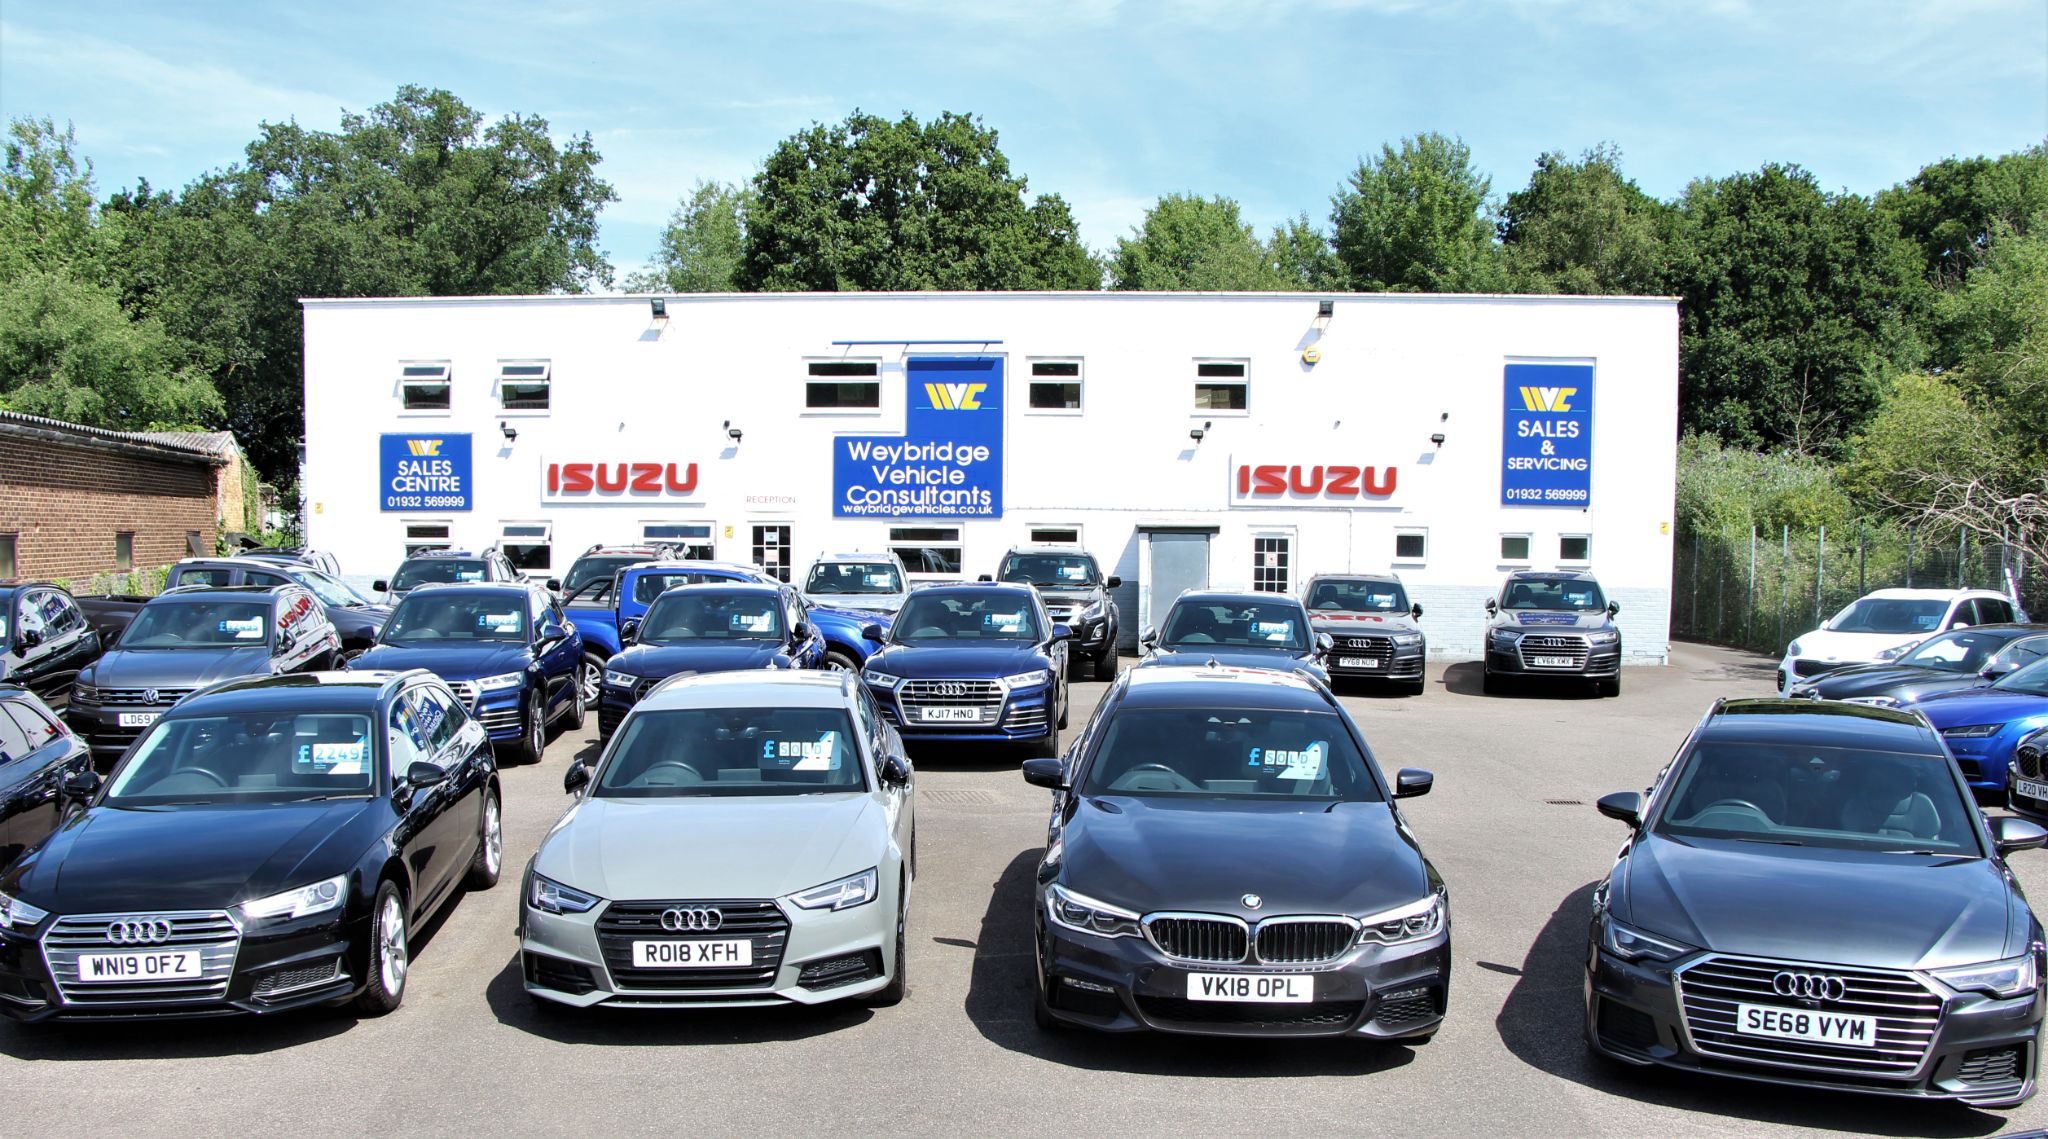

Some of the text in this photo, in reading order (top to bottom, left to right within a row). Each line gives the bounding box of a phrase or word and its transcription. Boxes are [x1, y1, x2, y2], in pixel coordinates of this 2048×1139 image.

[1517, 420, 1579, 438] SALES
[848, 441, 990, 466] Weybridge
[1540, 439, 1555, 455] &
[398, 460, 452, 476] SALES
[1507, 457, 1588, 471] SERVICING
[547, 463, 698, 492] ISUZU
[872, 465, 965, 484] Vehicle
[1239, 465, 1397, 496] ISUZU
[391, 476, 461, 492] CENTRE
[387, 496, 465, 507] 01932 569999
[746, 495, 796, 504] RECEPTION
[846, 485, 992, 505] Consultants
[1506, 488, 1587, 501] 01932 569999
[842, 504, 993, 516] weybridgevehicles.co.uk
[124, 714, 151, 724] LD69
[928, 709, 950, 719] KJ17
[780, 744, 822, 755] SOLD
[1266, 752, 1308, 764] SOLD
[2018, 781, 2037, 796] LR20
[645, 943, 738, 962] RO18 XFH
[92, 954, 187, 976] WN19 OFZ
[1201, 976, 1299, 998] VK18 OPL
[1747, 1008, 1866, 1041] SE68 VYM
